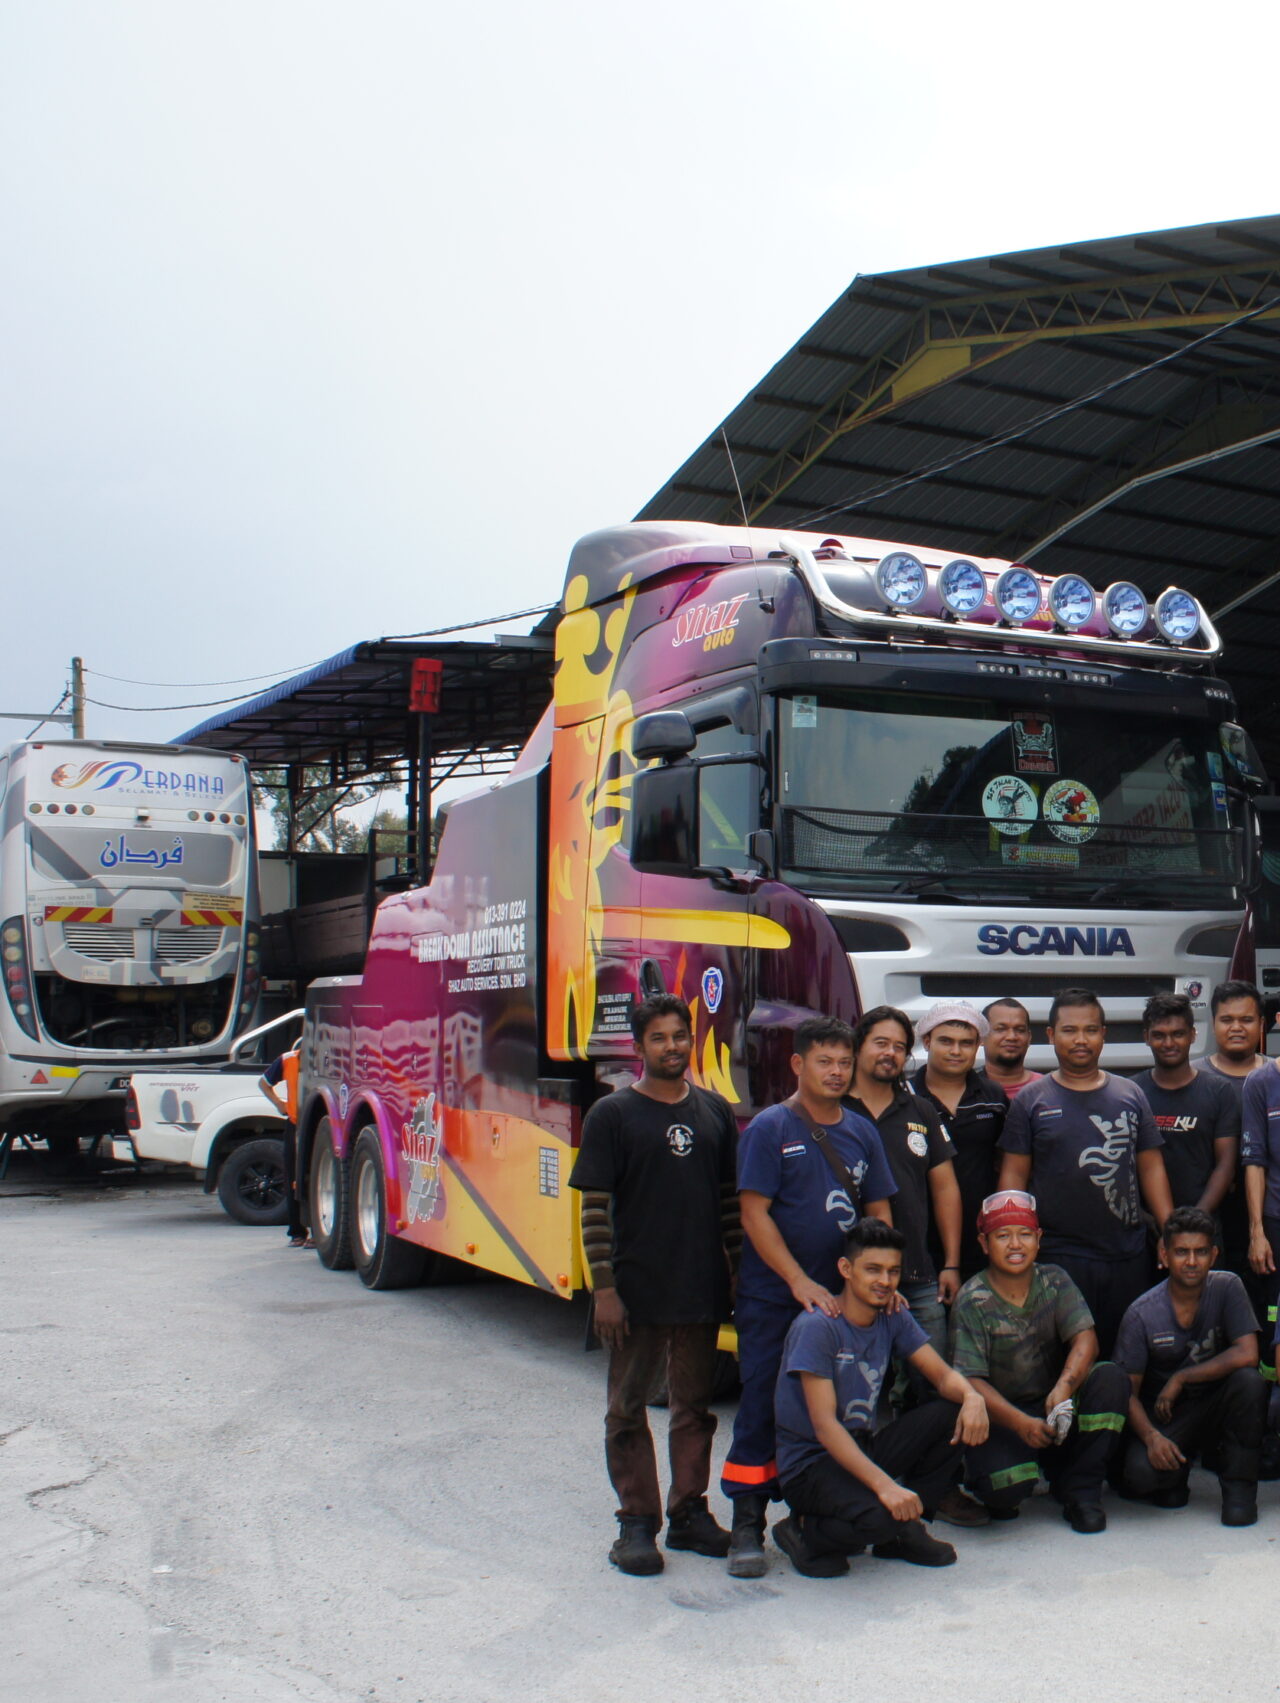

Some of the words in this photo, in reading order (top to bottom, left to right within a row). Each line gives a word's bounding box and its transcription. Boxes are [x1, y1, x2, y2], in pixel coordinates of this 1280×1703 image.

[703, 627, 735, 652] auto
[94, 761, 224, 795] PERDANA
[510, 899, 527, 920] 0224
[418, 931, 470, 964] BREAKDOWN
[472, 923, 525, 957] ASSISTANCE
[977, 924, 1136, 957] SCANIA
[467, 958, 493, 974] RECOVERY
[494, 956, 506, 971] TOW
[506, 953, 526, 969] TRUCK
[448, 979, 460, 993] SHAZ
[460, 977, 474, 992] AUTO
[513, 972, 526, 988] BHD
[1152, 1115, 1198, 1131] SSKU
